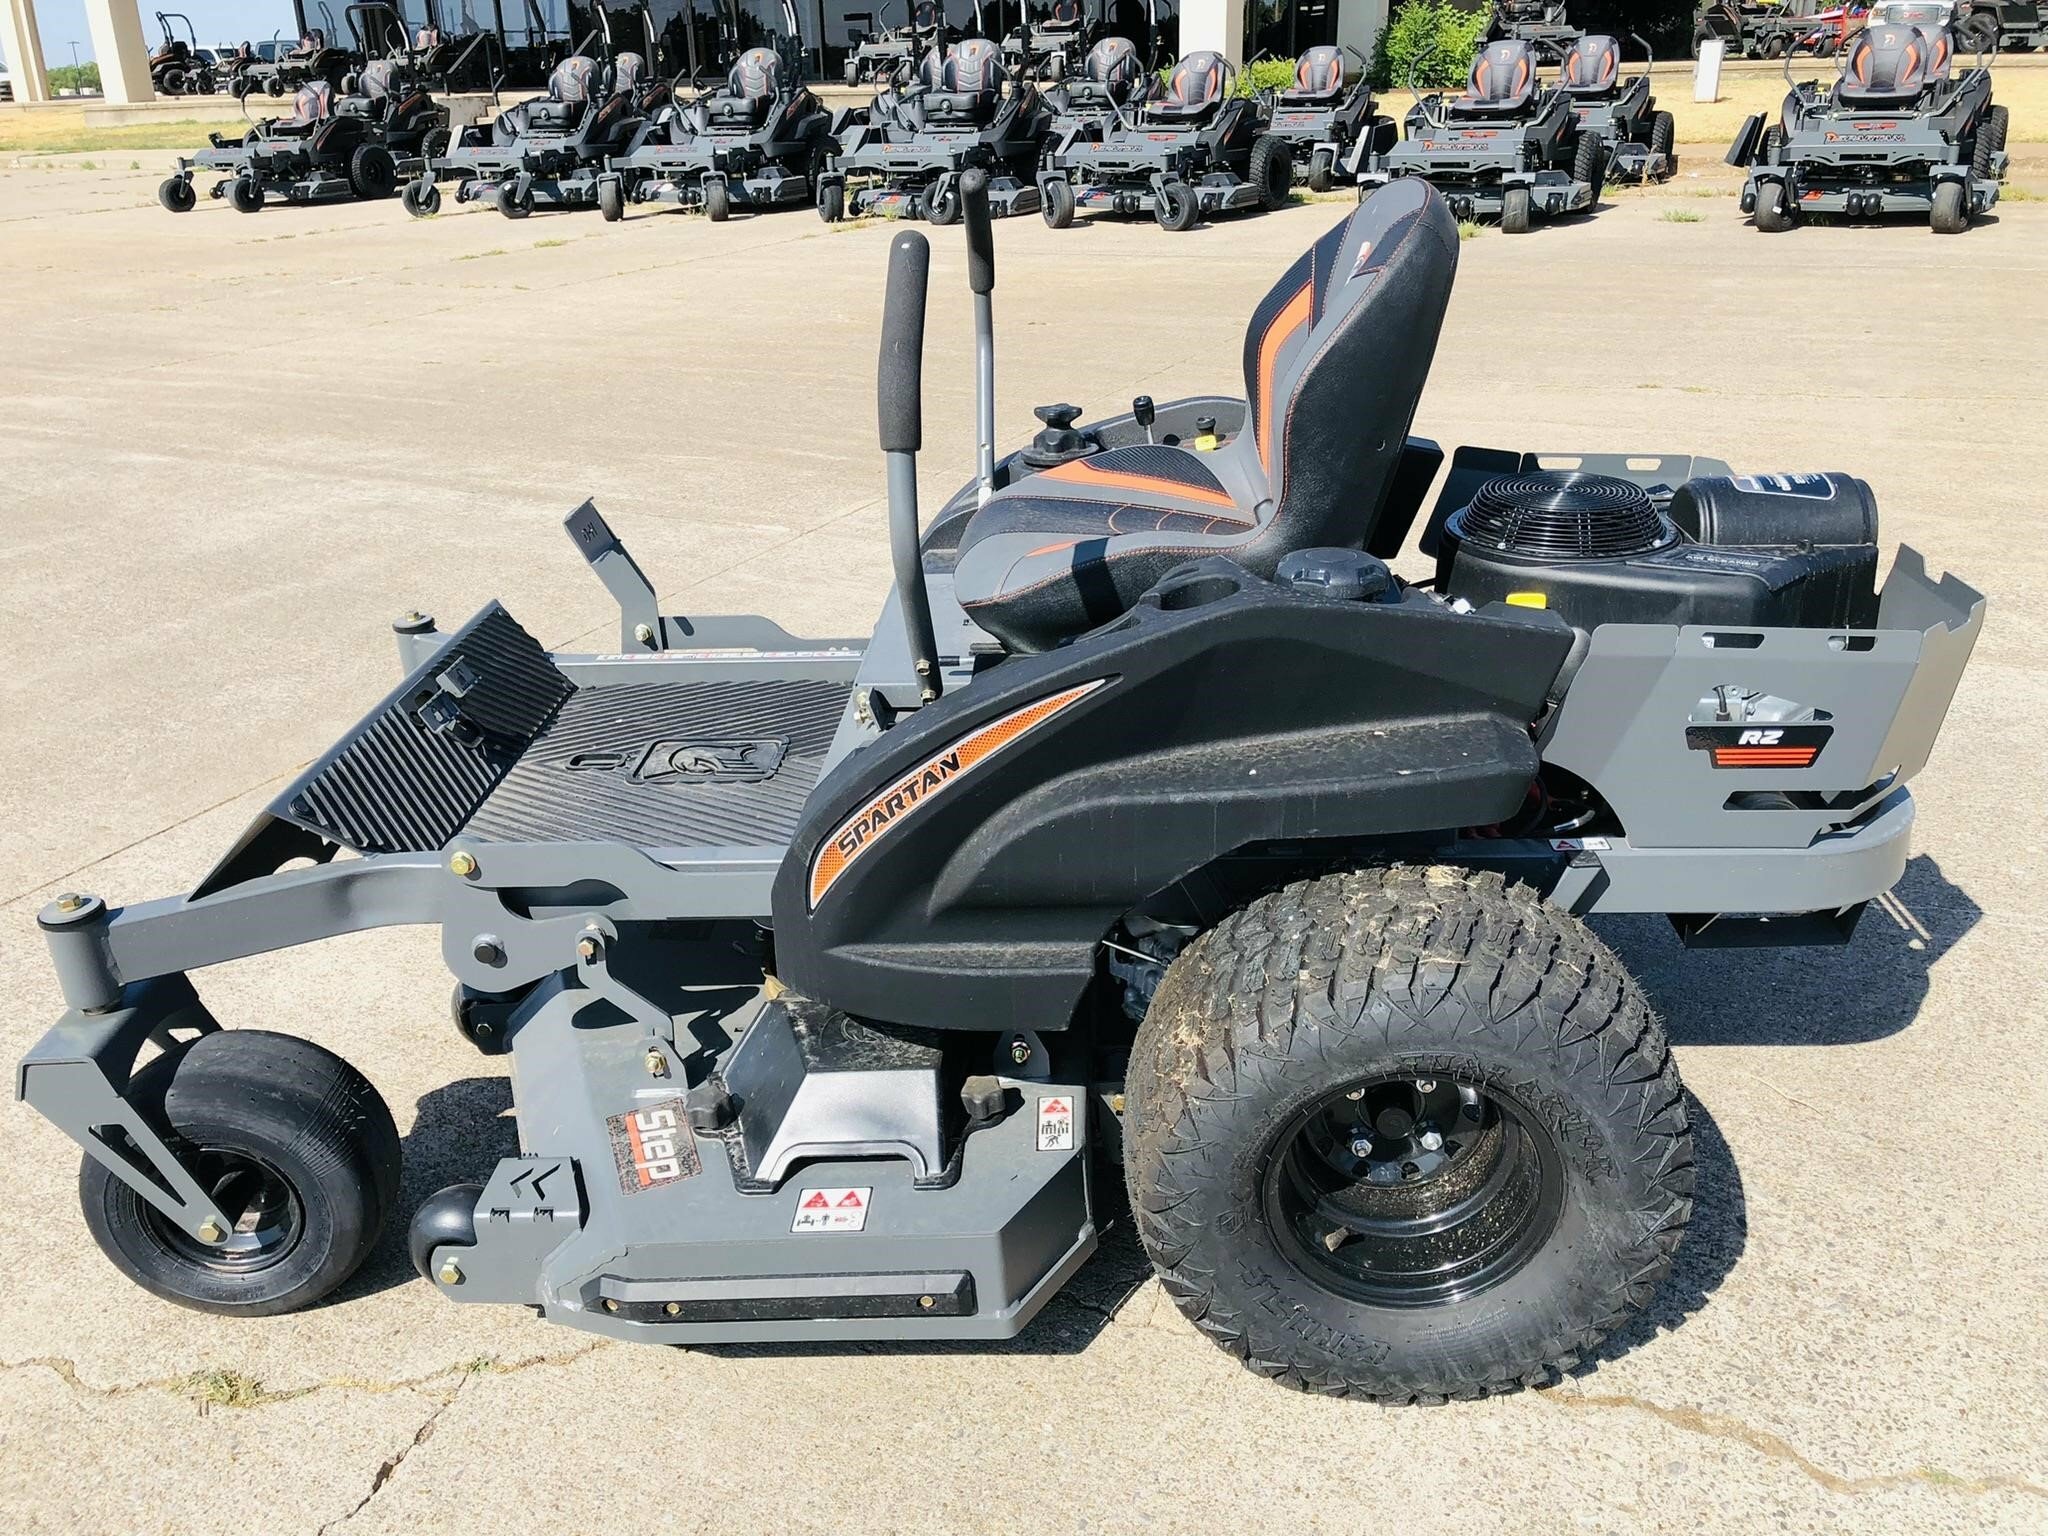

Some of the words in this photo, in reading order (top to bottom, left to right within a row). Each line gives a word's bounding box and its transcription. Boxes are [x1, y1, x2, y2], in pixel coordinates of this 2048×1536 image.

[1737, 729, 1785, 746] RZ
[837, 751, 961, 859] SPARTAN
[634, 1109, 681, 1180] Step
